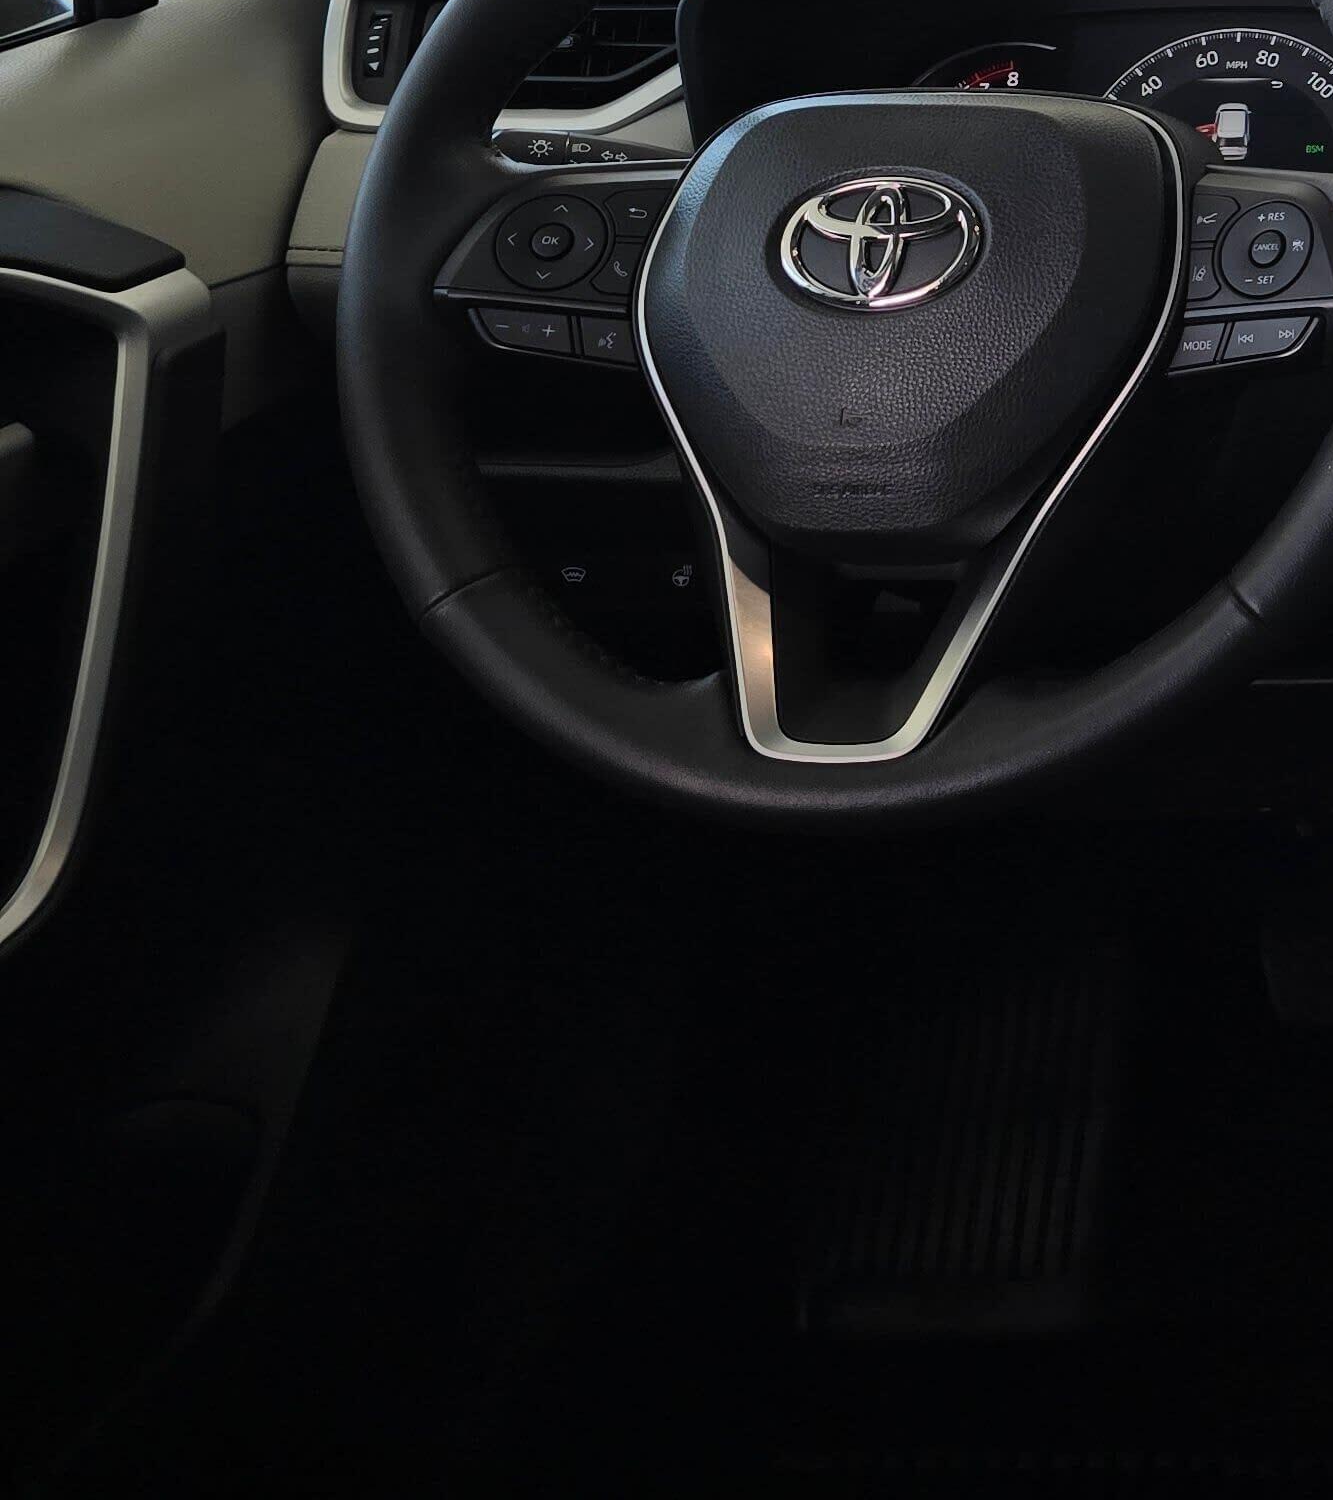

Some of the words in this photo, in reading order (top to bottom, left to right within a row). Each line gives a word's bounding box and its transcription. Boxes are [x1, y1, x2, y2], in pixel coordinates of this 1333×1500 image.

[1195, 50, 1219, 68] 60
[1255, 50, 1280, 68] 80
[1225, 60, 1248, 70] MPH
[1006, 71, 1019, 87] 8
[1141, 75, 1163, 98] 40
[1305, 145, 1324, 154] BSM
[1267, 212, 1286, 221] RES
[541, 235, 560, 245] OK
[1253, 243, 1280, 251] CANCEL
[1256, 275, 1275, 285] SET
[1183, 340, 1212, 351] MODE
